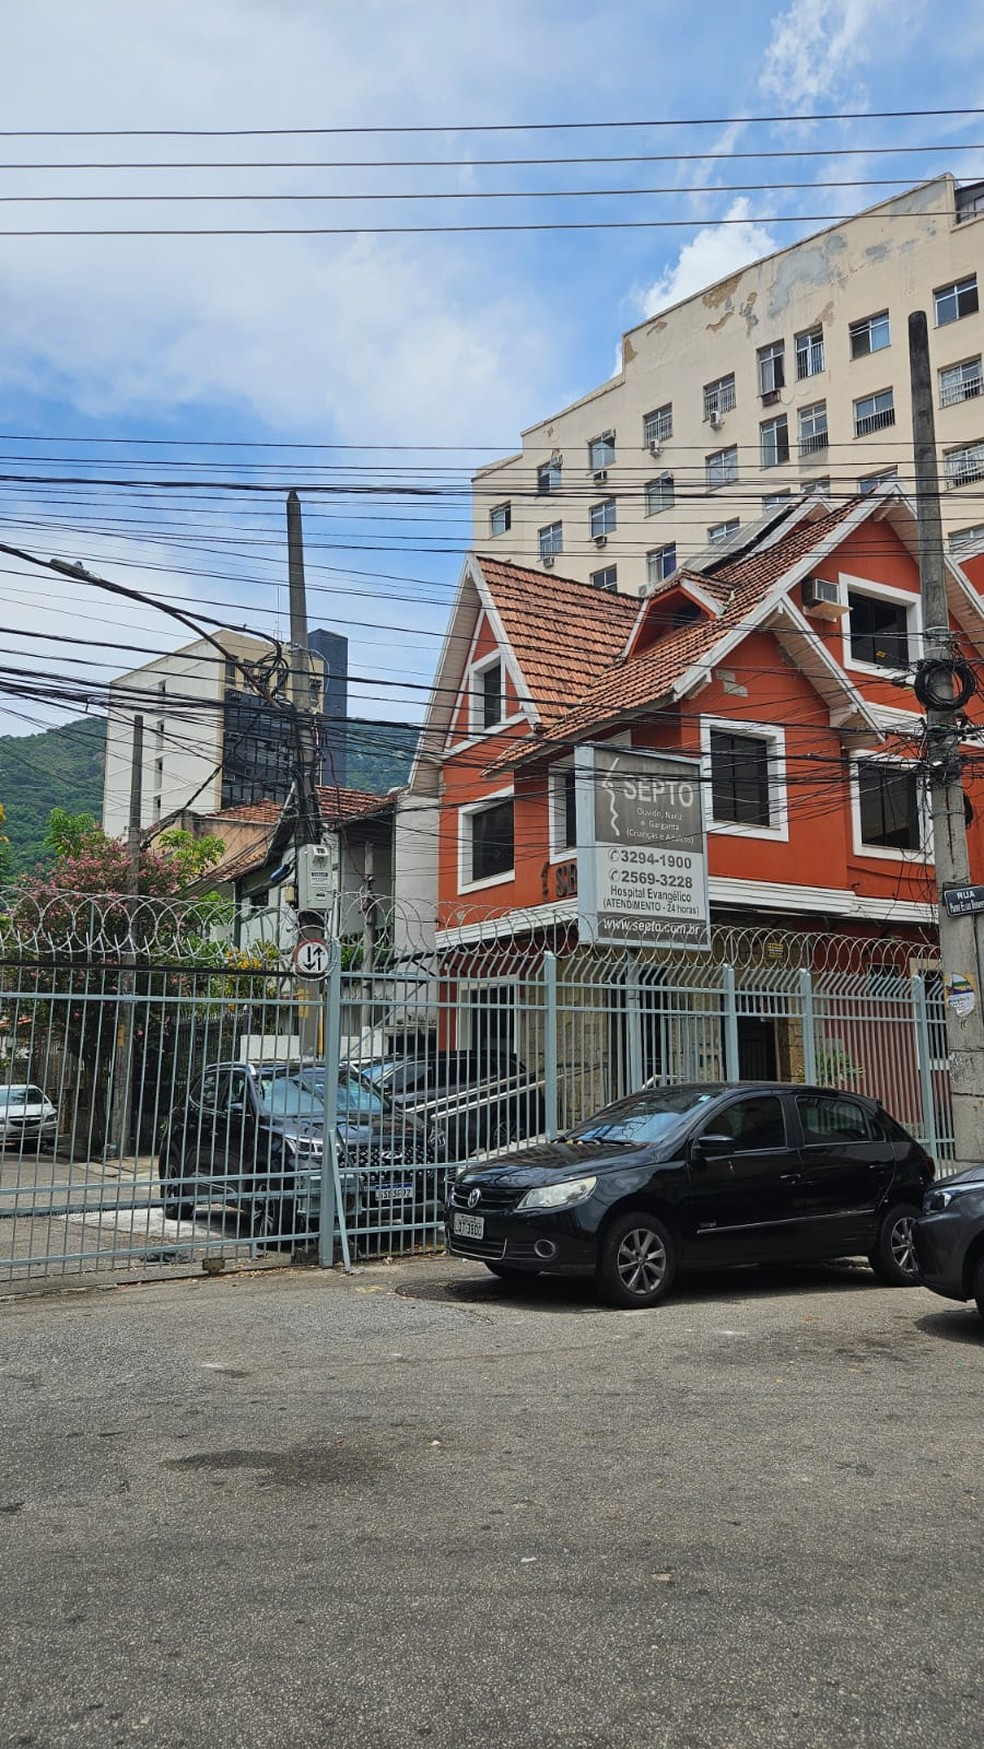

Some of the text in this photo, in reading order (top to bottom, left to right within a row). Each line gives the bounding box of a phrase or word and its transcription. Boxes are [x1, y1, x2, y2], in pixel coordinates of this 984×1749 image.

[623, 775, 694, 807] SEPTO
[621, 850, 692, 869] 3294-1900
[621, 870, 693, 888] 2569-3228
[610, 885, 691, 903] Hospital Evangélico
[956, 890, 975, 900] RUA
[602, 898, 661, 911] (ATENDIMENTO
[667, 904, 675, 913] 24
[677, 904, 700, 917] horas)
[603, 919, 700, 935] www.septo.com.br
